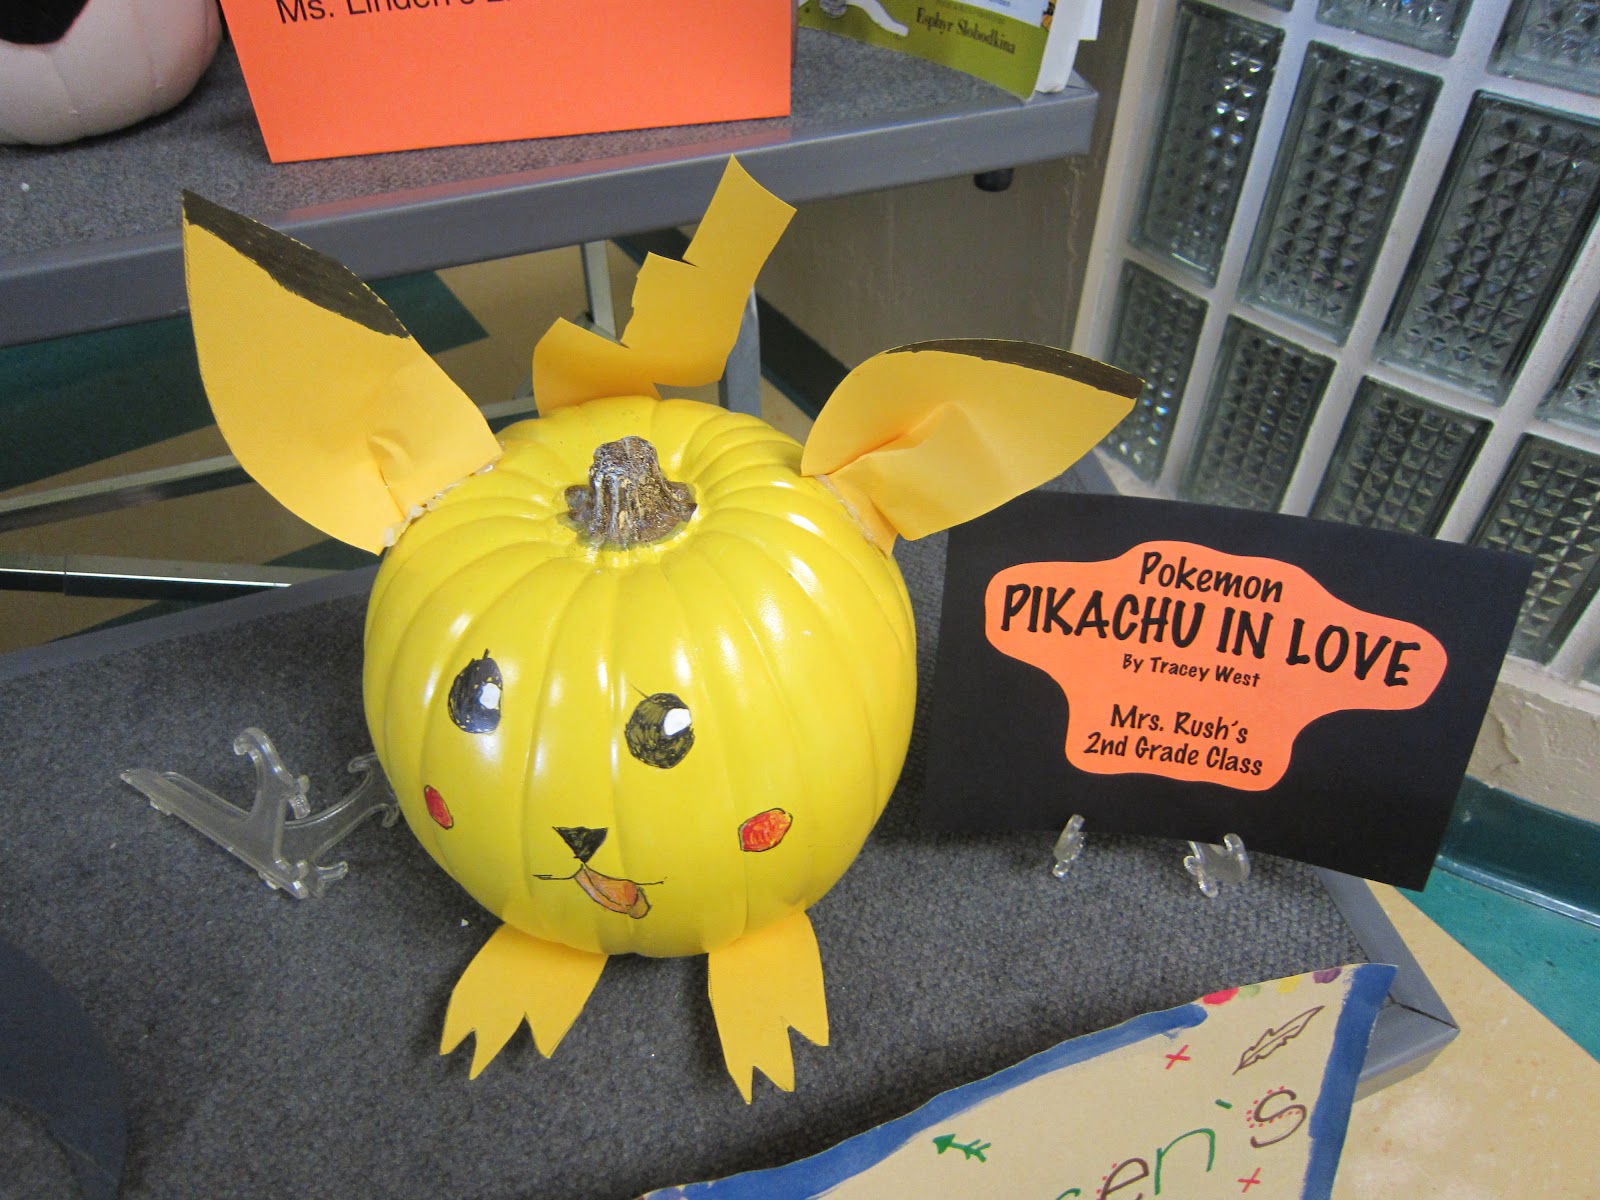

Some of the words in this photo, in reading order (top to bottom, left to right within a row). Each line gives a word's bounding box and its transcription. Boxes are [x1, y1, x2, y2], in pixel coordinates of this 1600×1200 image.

[276, 0, 335, 24] Ms.
[1139, 551, 1283, 603] Pokemon
[1000, 583, 1206, 649] PIKACHU
[1216, 606, 1274, 660] IN
[1285, 617, 1421, 688] LOVE
[1122, 653, 1144, 673] By
[1150, 656, 1210, 683] Tracey
[1215, 665, 1260, 688] West
[1110, 703, 1164, 732] Mrs.
[1173, 711, 1248, 744] Rush's
[1083, 731, 1129, 757] 2nd
[1135, 735, 1199, 766] Grade
[1206, 745, 1263, 776] Class
